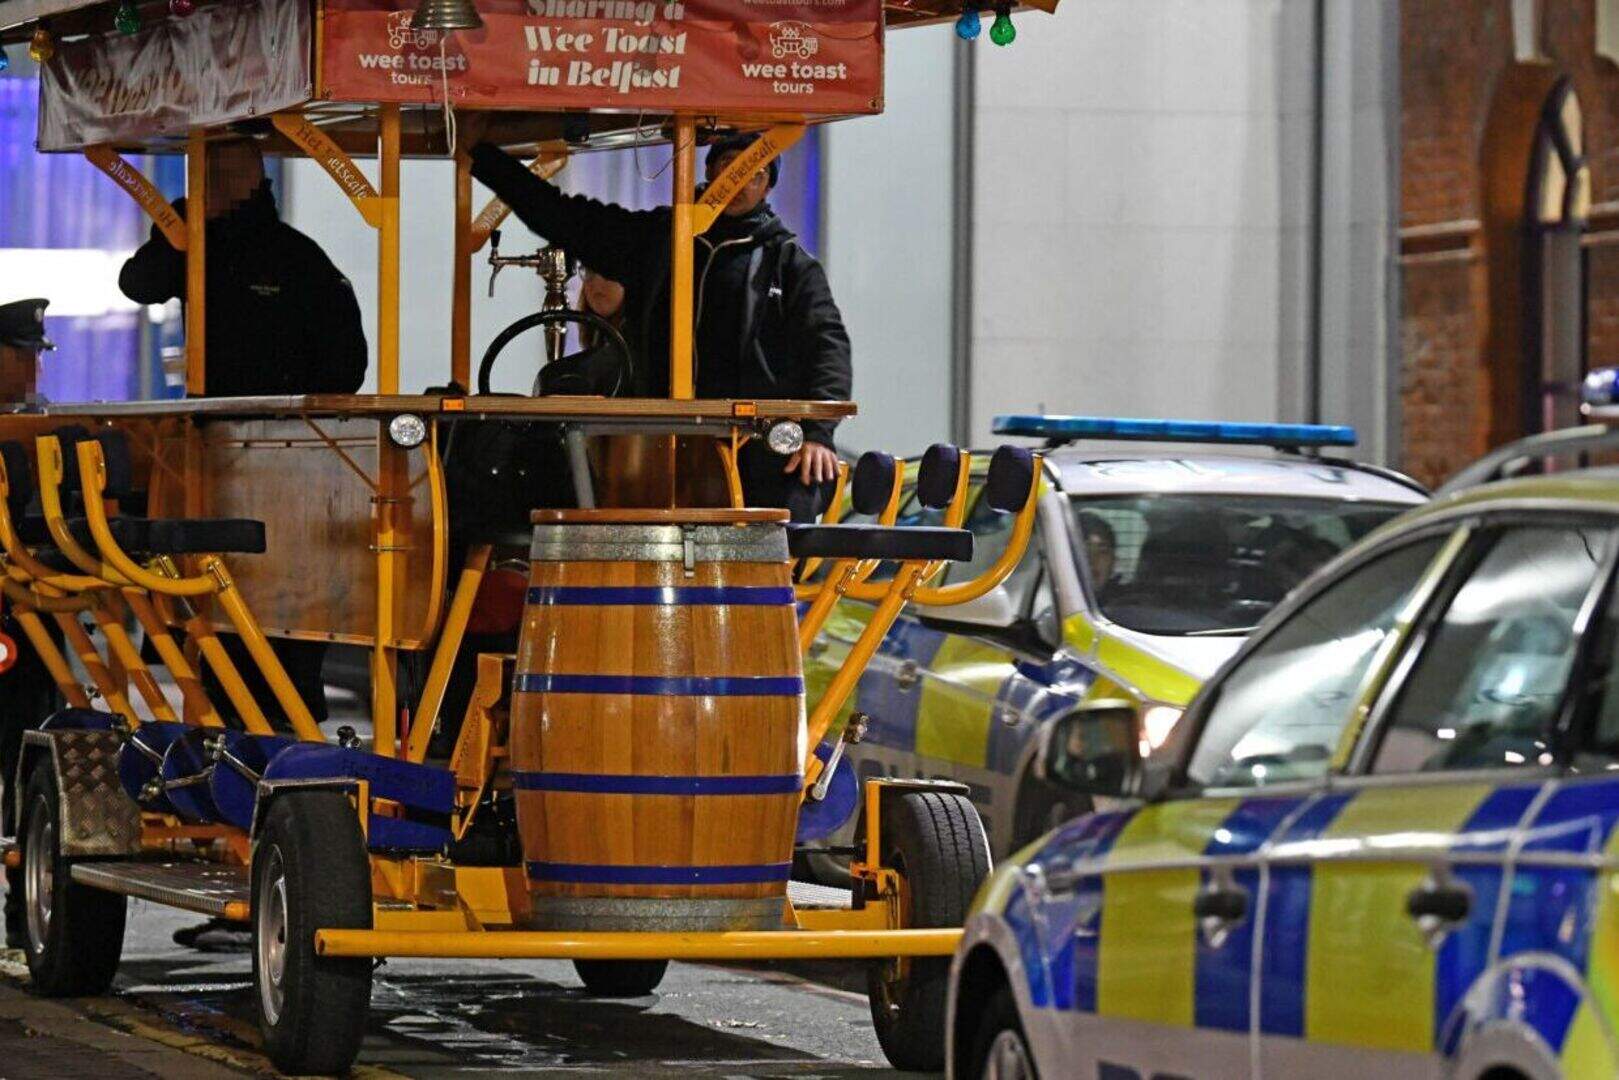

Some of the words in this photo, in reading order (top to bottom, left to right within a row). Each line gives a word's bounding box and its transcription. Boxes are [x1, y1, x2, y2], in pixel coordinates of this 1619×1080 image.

[527, 0, 656, 26] Sharing
[663, 3, 685, 20] a
[524, 26, 595, 53] Wee
[602, 28, 688, 55] Toast
[359, 53, 405, 69] wee
[408, 52, 467, 71] toast
[741, 63, 787, 79] wee
[790, 62, 848, 80] toast
[391, 70, 433, 85] tours
[527, 58, 560, 87] in
[566, 60, 681, 95] Belfast
[772, 80, 815, 95] tours
